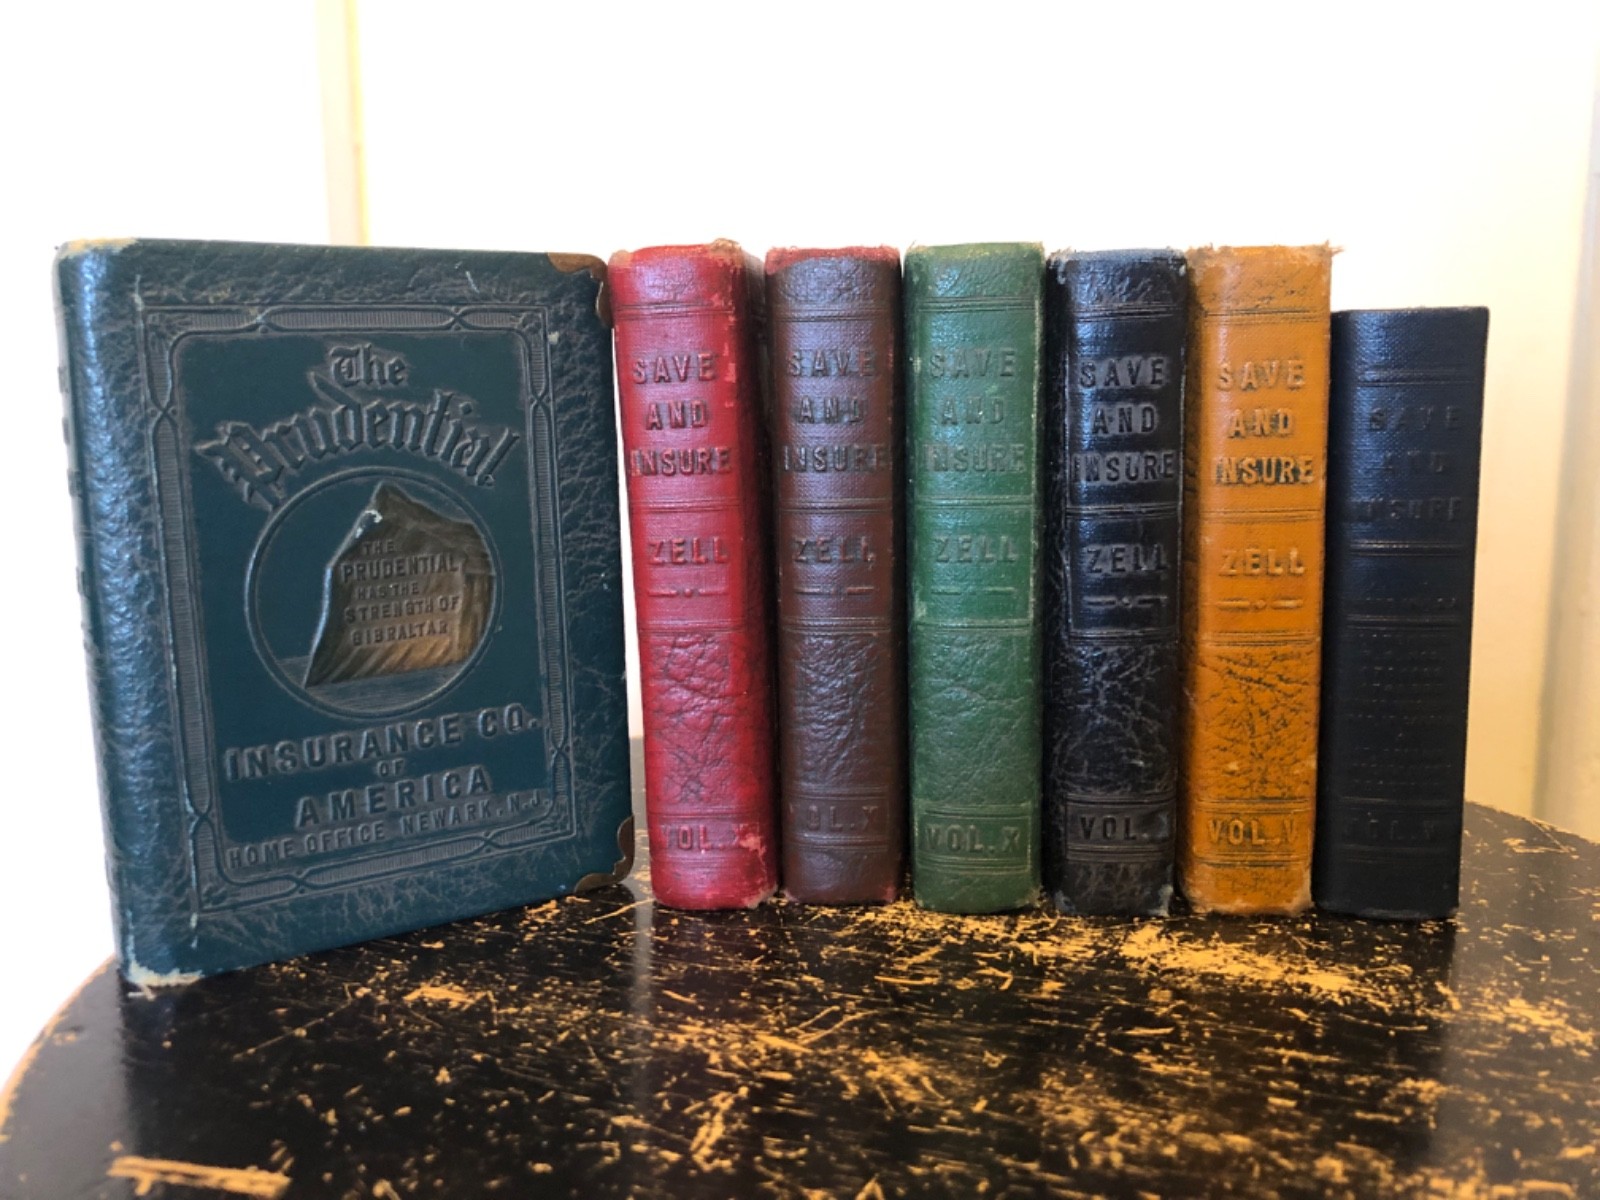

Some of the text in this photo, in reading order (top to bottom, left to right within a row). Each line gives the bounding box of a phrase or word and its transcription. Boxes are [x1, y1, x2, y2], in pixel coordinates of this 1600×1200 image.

[328, 343, 408, 388] The
[632, 353, 717, 384] SAVE
[788, 350, 875, 377] SAVE
[929, 349, 1017, 379] SAVE
[1079, 358, 1168, 388] SAVE
[1216, 359, 1306, 391] SAVE
[646, 402, 707, 430] AND
[798, 396, 862, 424] AND
[939, 396, 1006, 427] AND
[1092, 405, 1158, 434] AND
[1228, 408, 1294, 439] AND
[196, 371, 520, 512] Prudential
[629, 447, 733, 476] INSURE
[923, 444, 1025, 473] INSURE
[1070, 453, 1174, 483] INSURE
[363, 540, 396, 555] THE
[648, 536, 728, 564] ZELL
[795, 536, 875, 563] ZELL
[934, 536, 1018, 564] ZELL
[1087, 545, 1168, 573] ZELL
[342, 553, 460, 584] PRUDENTIAL
[1219, 549, 1305, 577] ZELL
[355, 582, 420, 600] HAS THE
[345, 594, 461, 624] STRENGTH OF
[351, 620, 450, 647] GIBRALTAR
[225, 703, 538, 780] INSURANCE CO.
[376, 759, 404, 778] OF
[296, 765, 491, 829] AMERICA
[229, 838, 296, 869] HOME
[304, 823, 386, 852] OFFICE
